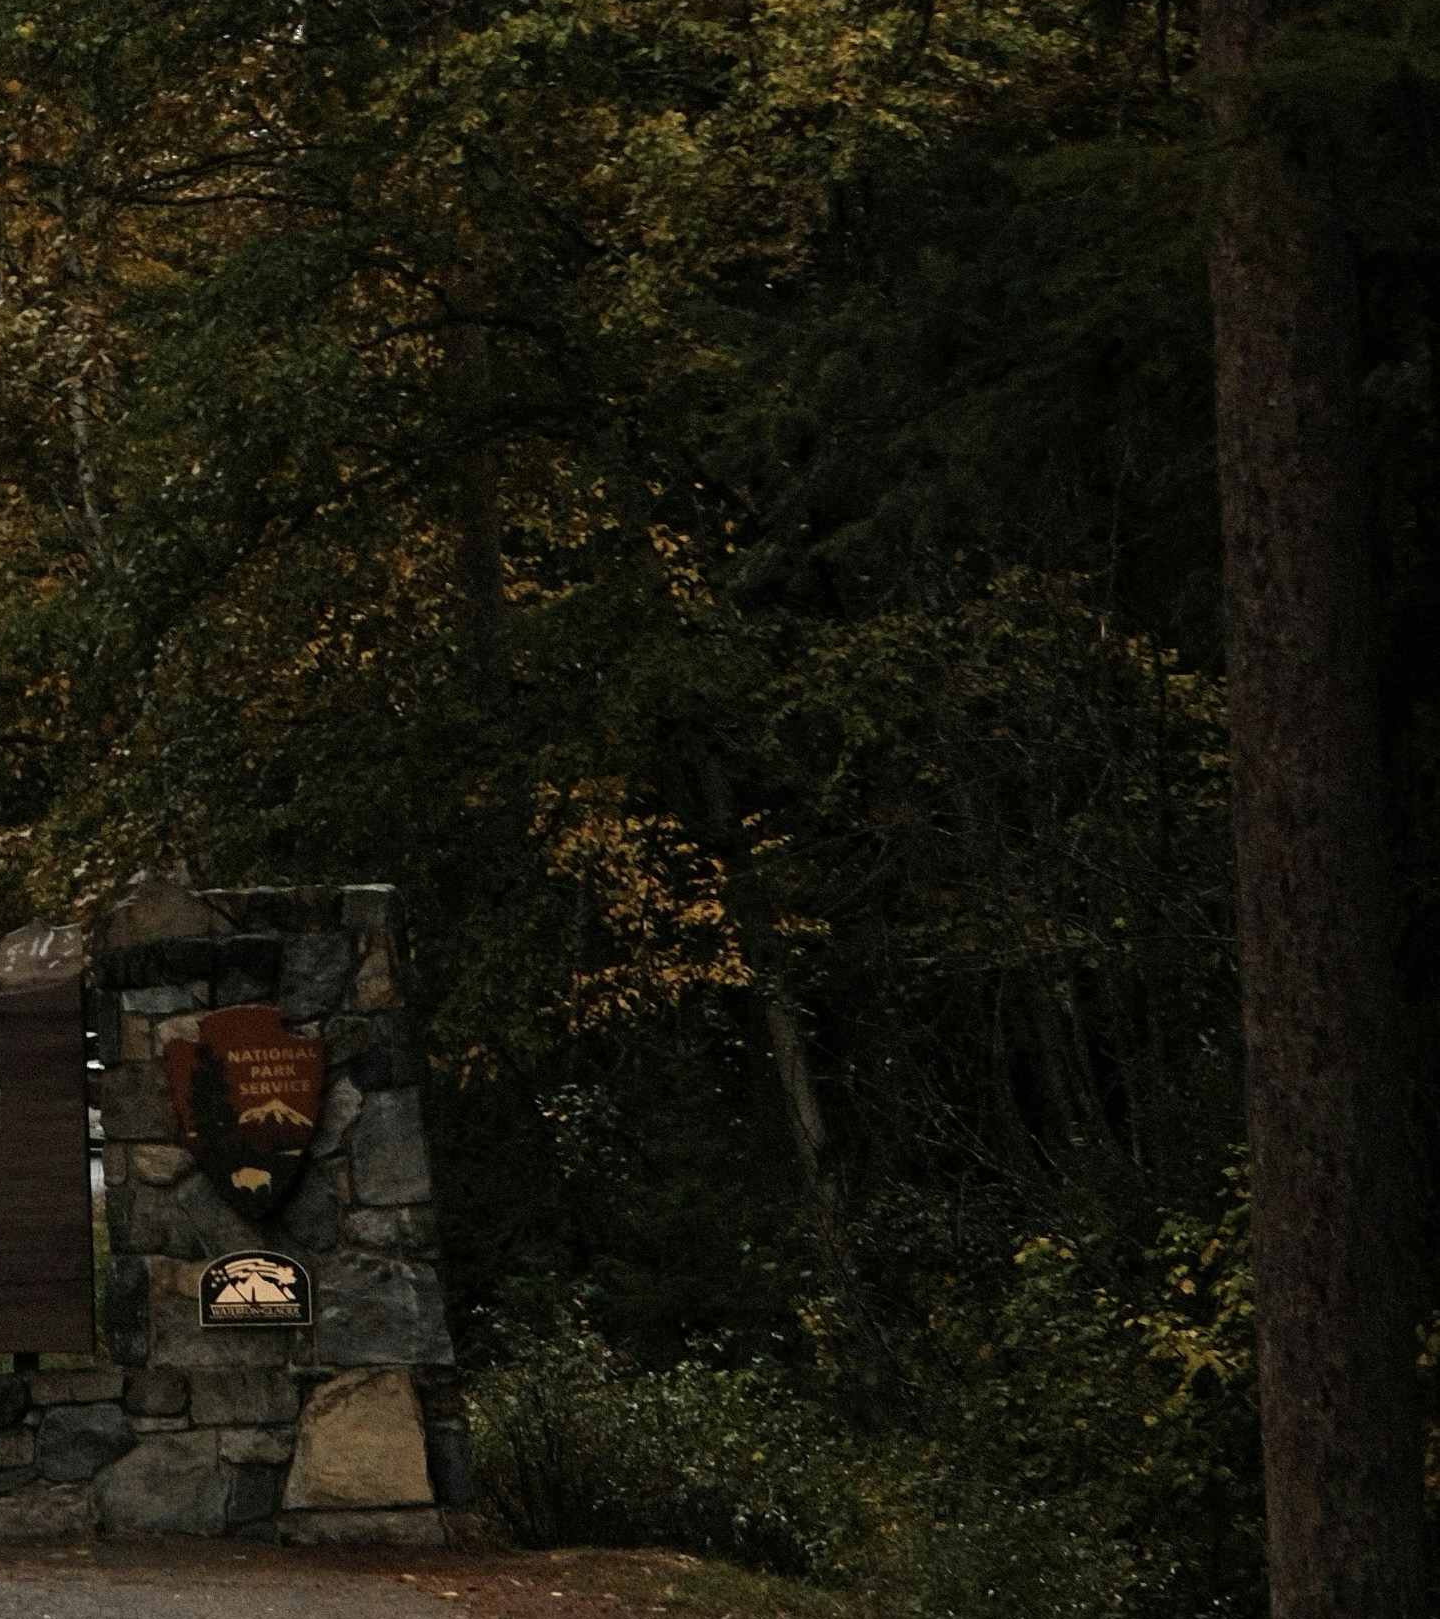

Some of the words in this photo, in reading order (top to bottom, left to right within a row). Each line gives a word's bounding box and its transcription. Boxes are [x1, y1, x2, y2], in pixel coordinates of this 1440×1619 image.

[228, 1047, 317, 1062] NATIONAL
[252, 1064, 296, 1077] PARK
[238, 1080, 311, 1094] SERVICE
